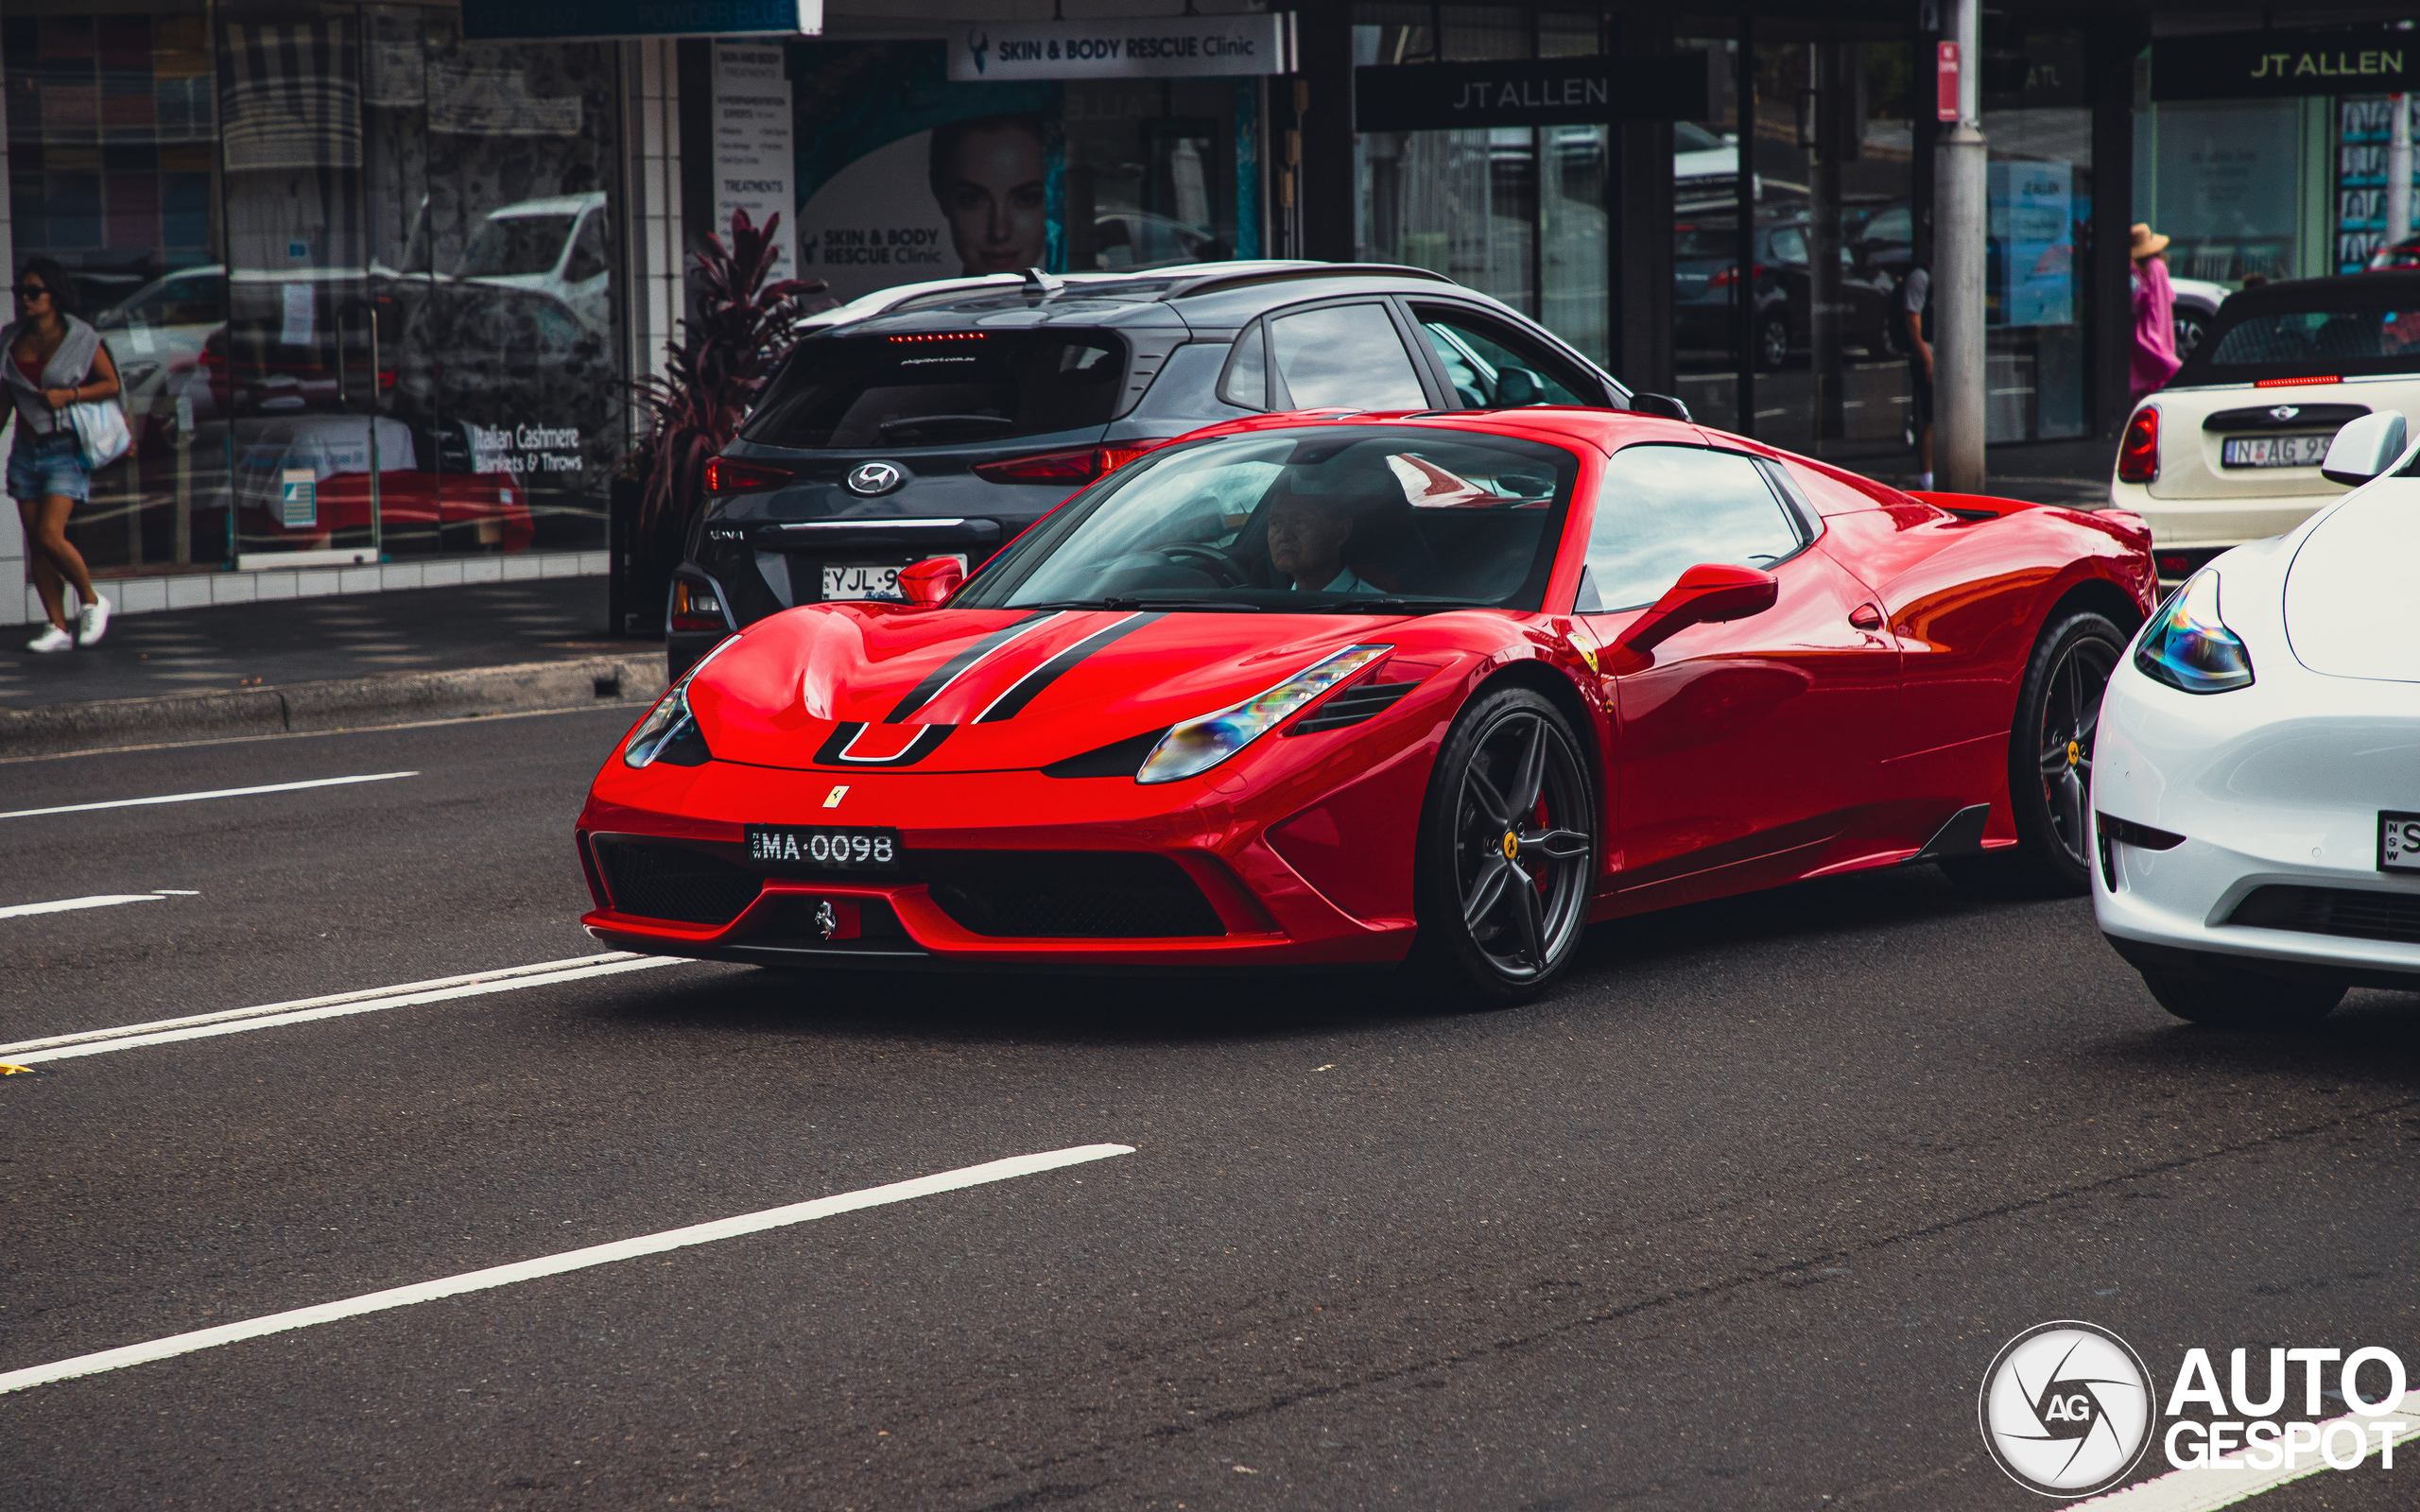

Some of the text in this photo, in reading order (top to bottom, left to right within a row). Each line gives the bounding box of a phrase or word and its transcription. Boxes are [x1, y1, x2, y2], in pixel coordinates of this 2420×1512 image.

[638, 1, 791, 26] POWDER BLUE
[998, 35, 1255, 60] SKIN & BODY RESCUE Clinic
[2250, 49, 2404, 78] JT ALLEN
[1452, 77, 1609, 109] JT ALLEN
[724, 180, 784, 193] TREATMENTS
[824, 229, 939, 247] SKIN & BODY
[824, 248, 942, 265] RESCUE Clinic
[475, 422, 514, 450] Italian
[516, 421, 580, 451] Cashmere
[527, 452, 540, 473] &
[541, 451, 583, 472] Throws
[832, 567, 898, 592] YJL·9
[752, 833, 762, 859] NSW
[2386, 822, 2399, 861] NSW
